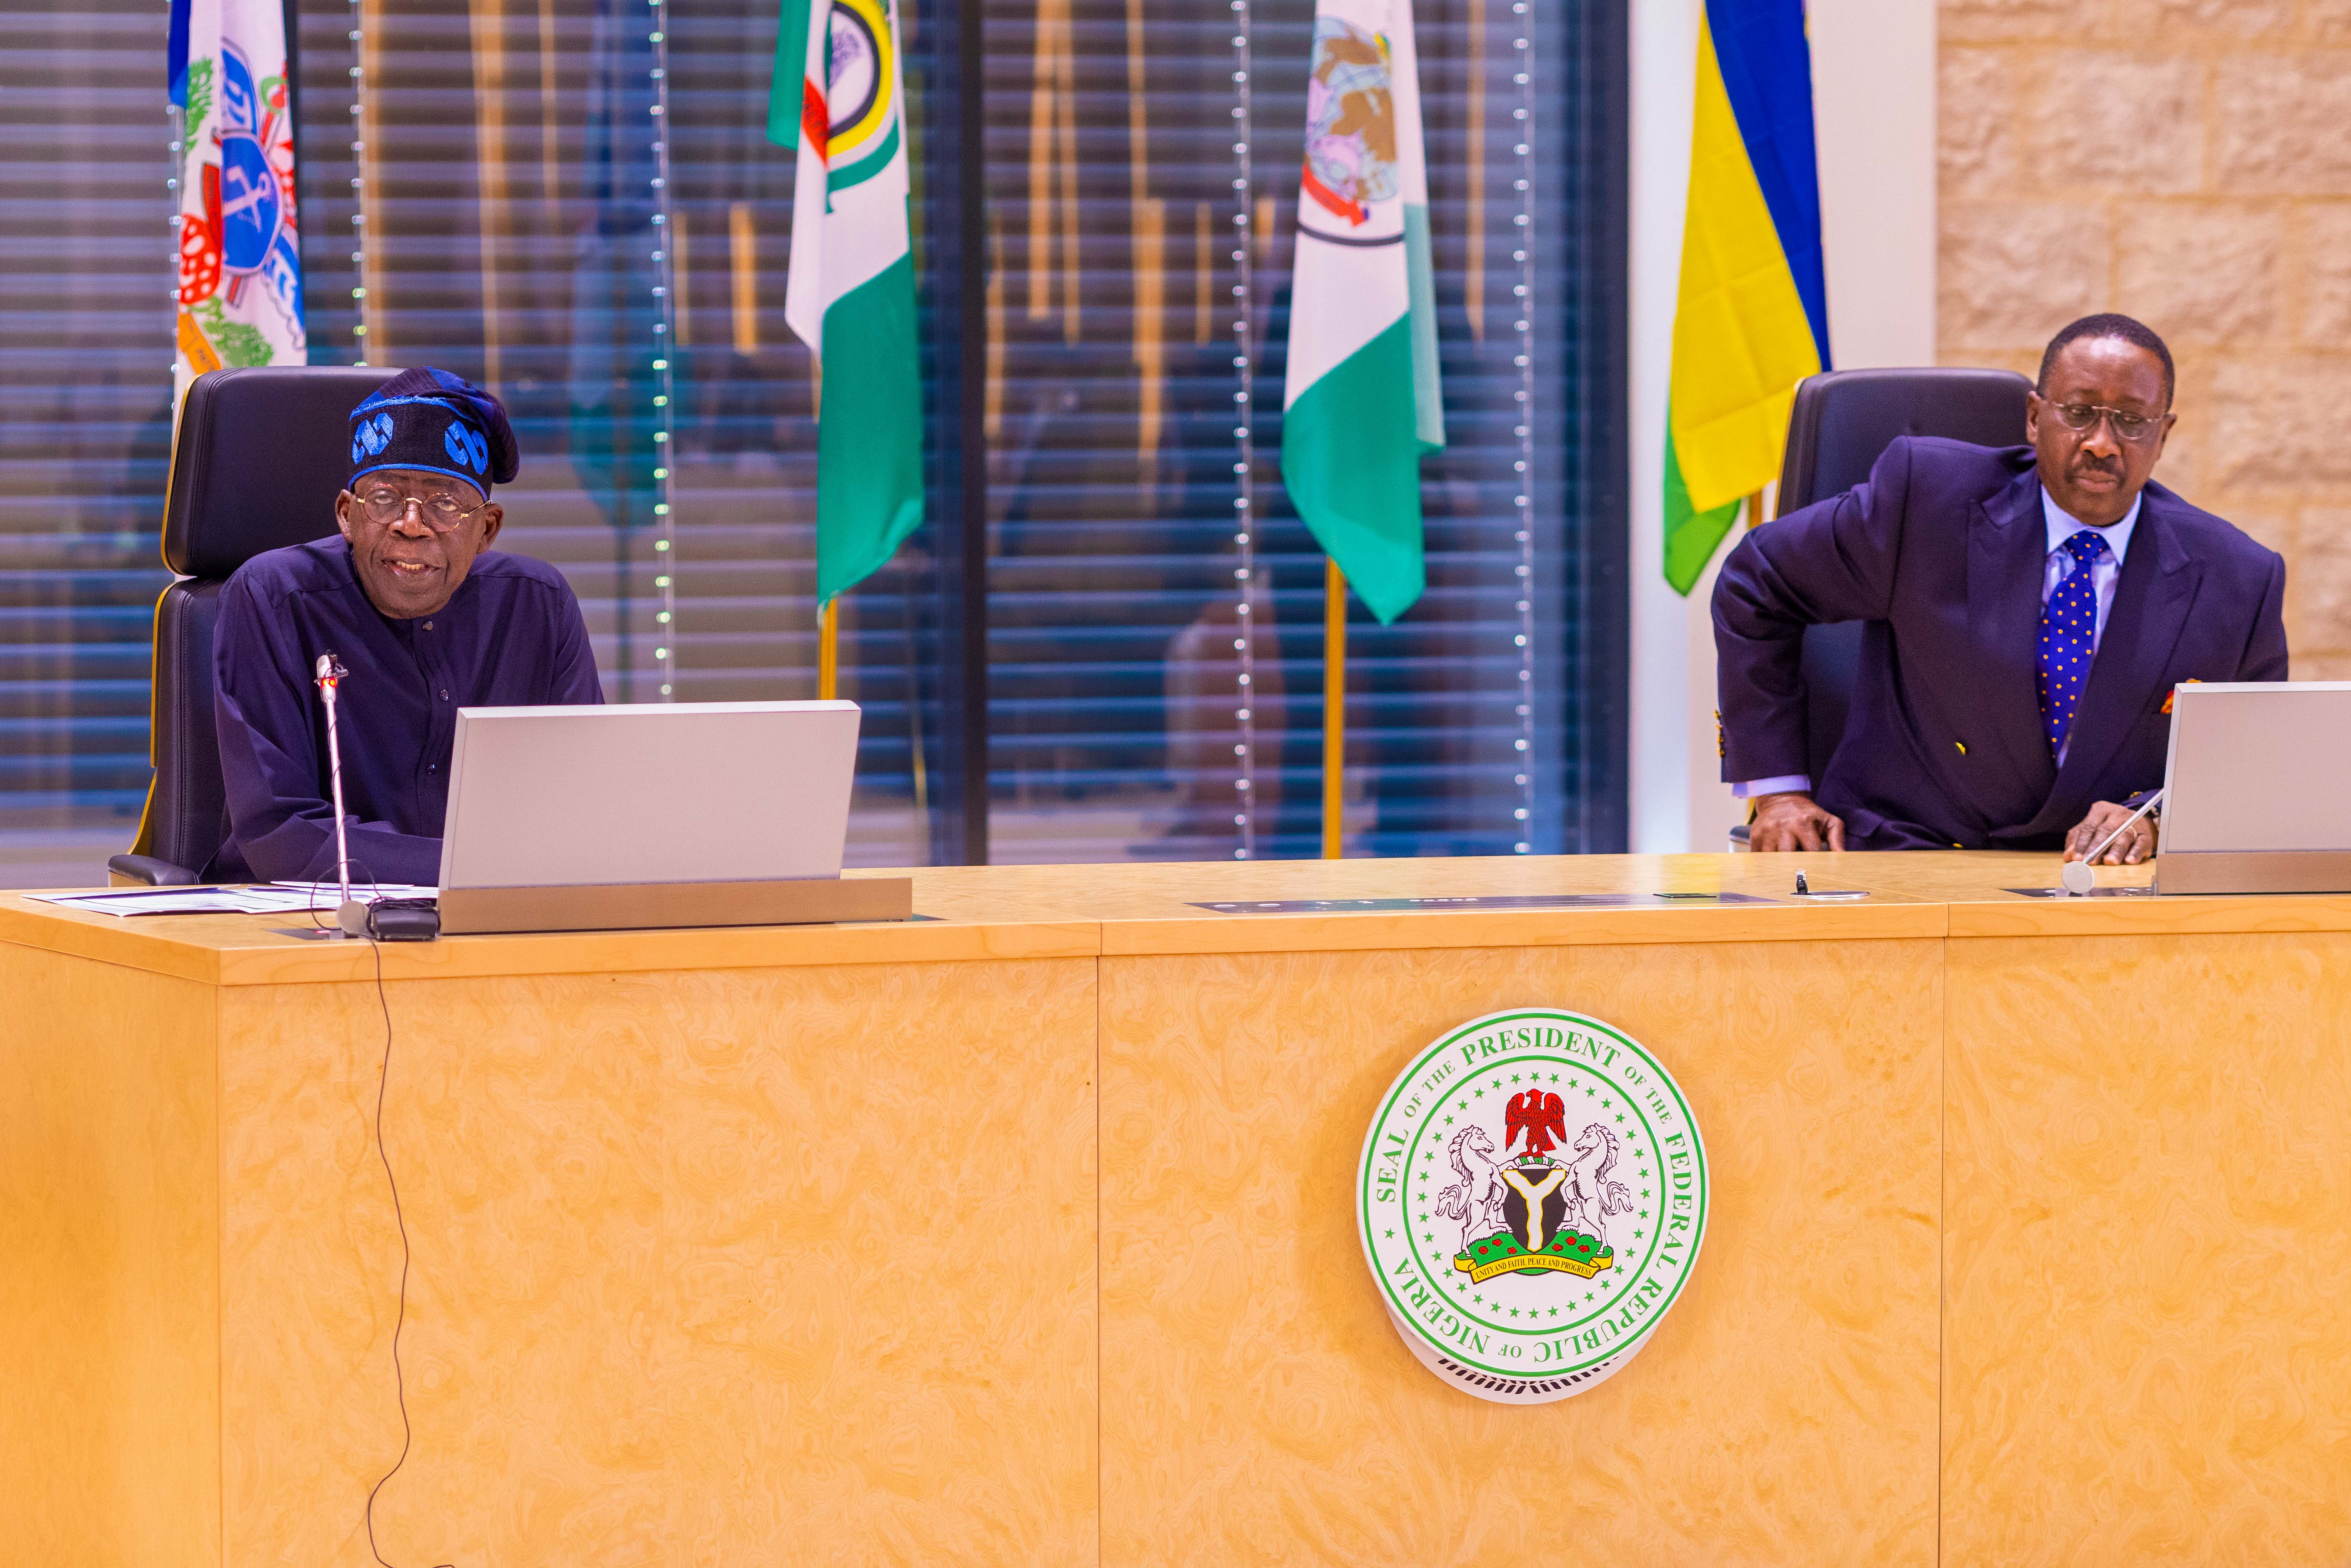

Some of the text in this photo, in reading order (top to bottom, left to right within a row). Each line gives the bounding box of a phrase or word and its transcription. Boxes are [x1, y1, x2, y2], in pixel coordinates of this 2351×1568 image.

[1377, 1027, 1693, 1363] SEAL OF THE PRESIDENT OF THE FEDERAL REPUBLIC OF NIGERIA
[1476, 1267, 1494, 1279] UNITY
[1495, 1262, 1507, 1272] AND
[1508, 1258, 1527, 1268] FAITH,
[1561, 1261, 1592, 1276] PROGRESS
